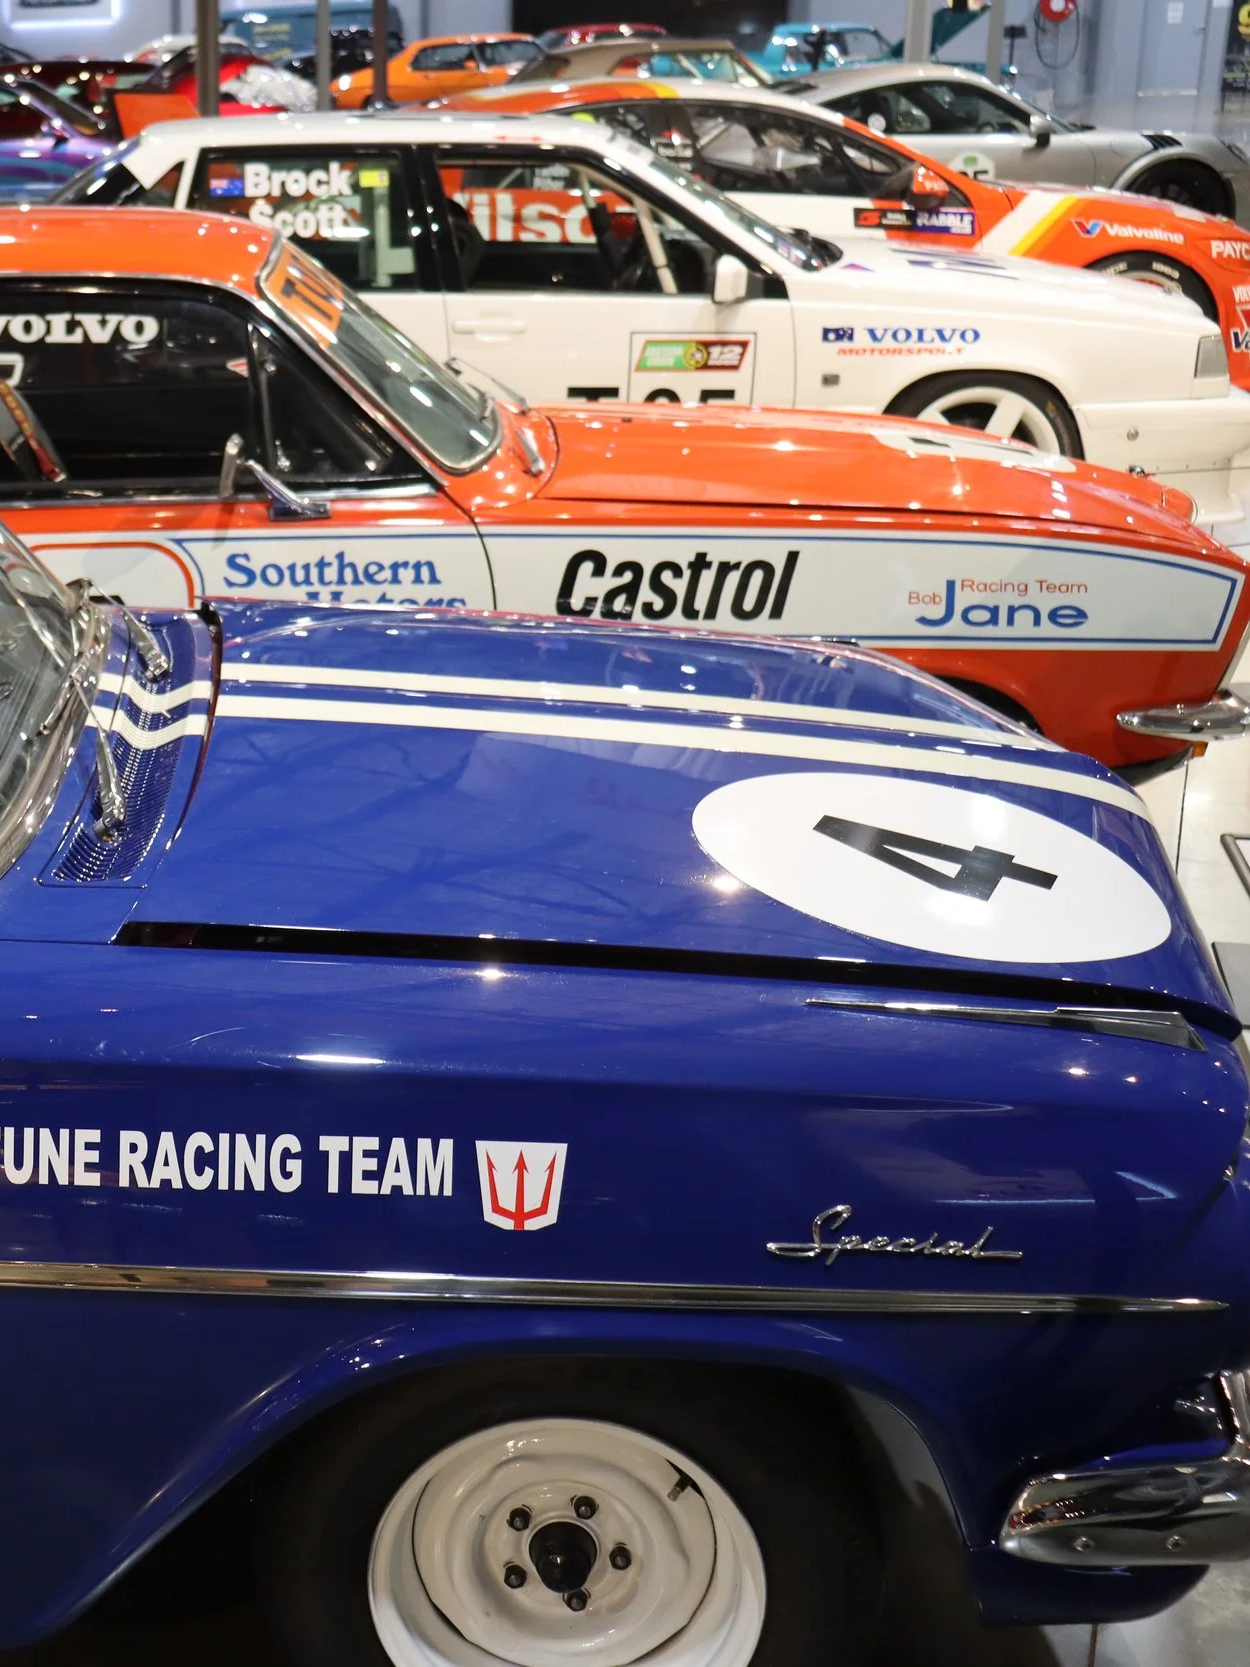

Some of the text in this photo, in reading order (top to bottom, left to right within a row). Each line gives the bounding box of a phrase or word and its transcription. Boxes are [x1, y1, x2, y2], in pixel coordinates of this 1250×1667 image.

[244, 161, 354, 198] Brock
[248, 200, 355, 238] Scott
[1104, 222, 1185, 246] Valvoline
[864, 327, 981, 344] VOLVO
[223, 550, 442, 588] Southern
[555, 549, 801, 621] Castrol
[960, 578, 1089, 597] Racing Team
[907, 579, 1089, 629] Bob Jane
[812, 814, 1059, 902] 4
[118, 1130, 303, 1194] RACING
[318, 1135, 454, 1196] TEAM
[766, 1204, 1024, 1266] Special
